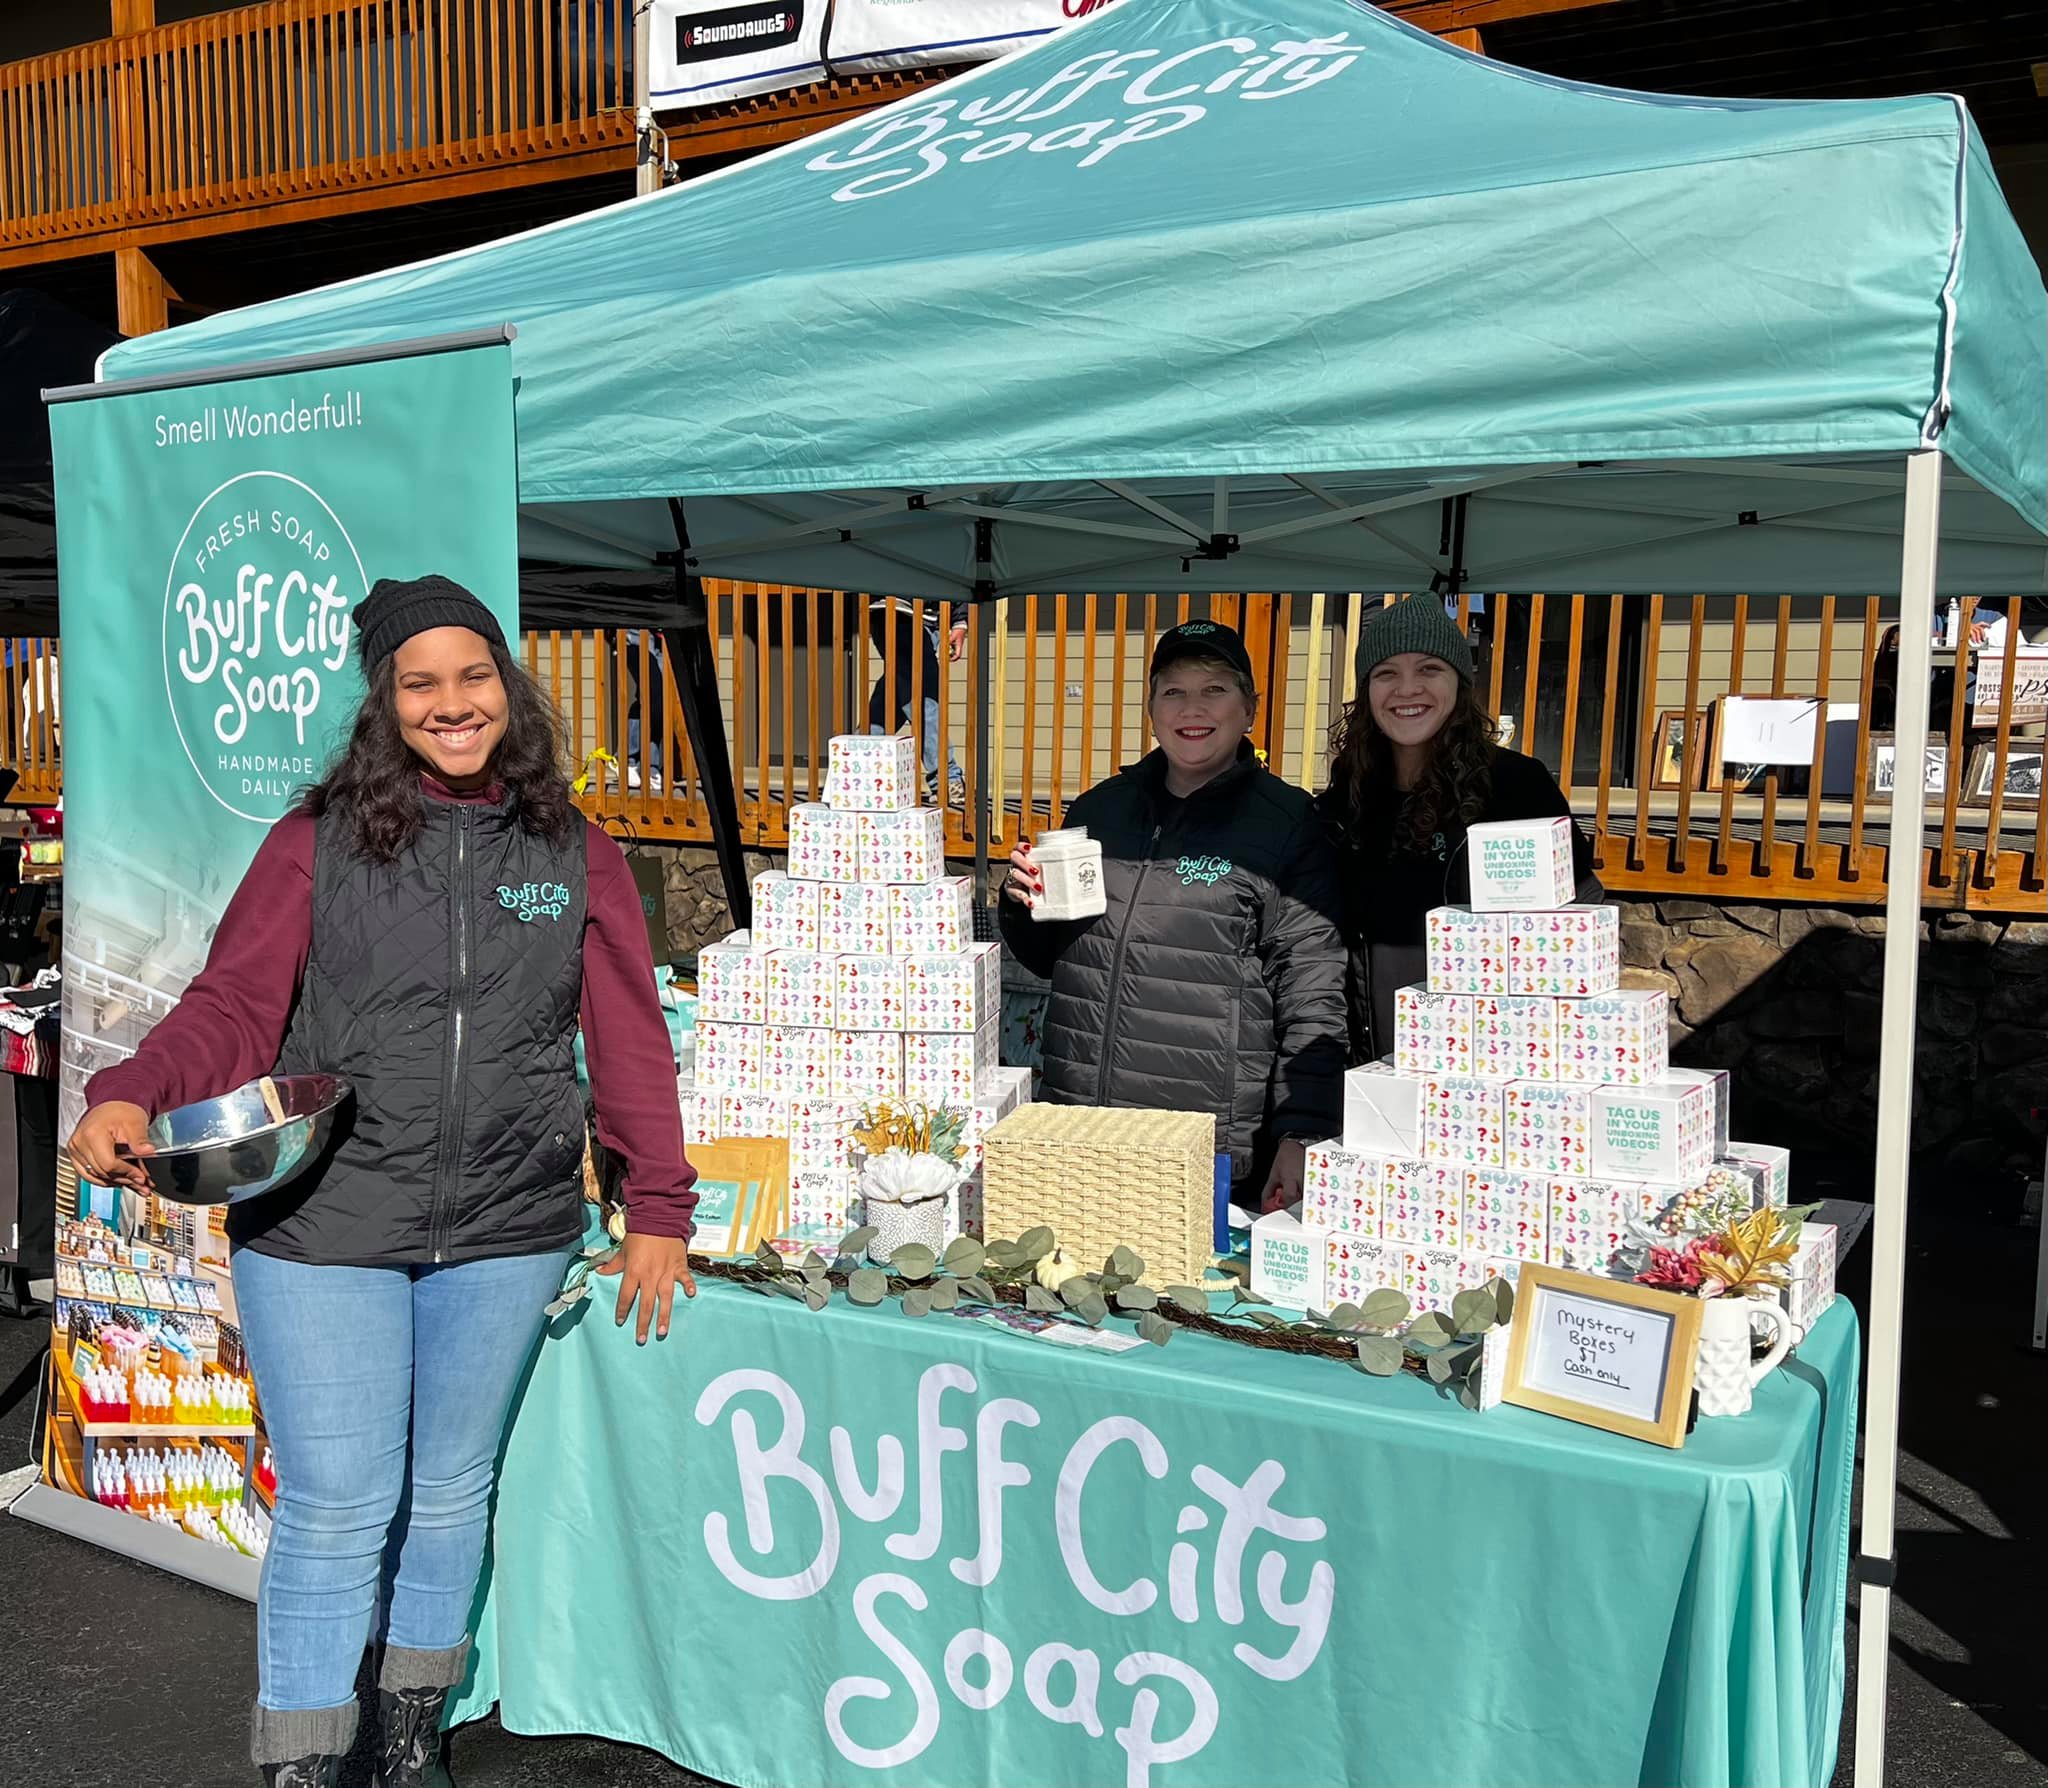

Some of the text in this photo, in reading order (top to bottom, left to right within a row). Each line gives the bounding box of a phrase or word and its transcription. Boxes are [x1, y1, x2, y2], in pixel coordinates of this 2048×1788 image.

[804, 31, 1367, 171] Buff City
[830, 104, 1207, 202] Soap
[155, 390, 363, 447] Smell Wonderful!
[195, 509, 330, 574] FRESH SOAP
[175, 563, 350, 684] Buff City
[214, 658, 320, 745] Soap
[218, 755, 313, 774] HANDMADE
[242, 779, 291, 796] DAILY
[1482, 839, 1536, 850] TAG US
[1176, 855, 1232, 875] Buff City
[1484, 851, 1535, 861] IN YOUR
[1484, 861, 1536, 869] UNBOXING
[1182, 870, 1218, 887] Soap
[1484, 869, 1536, 879] VIDEOS!
[496, 882, 569, 908] Buff City
[518, 902, 562, 921] Soap
[1606, 1107, 1660, 1120] TAG US
[1607, 1119, 1659, 1131] IN YOUR
[1607, 1129, 1660, 1140] UNBOXING
[1607, 1137, 1660, 1150] VIDEOS!
[1263, 1239, 1309, 1256] TAG US
[1263, 1259, 1308, 1273] UNBOXING
[1264, 1250, 1308, 1265] IN YOUR
[1263, 1267, 1308, 1283] VIDEOS!
[1558, 1309, 1634, 1344] Mystery
[1569, 1330, 1616, 1354] Boxes
[1580, 1347, 1596, 1363] $7
[1564, 1358, 1620, 1384] Cash only
[694, 1363, 1336, 1682] Buff City
[823, 1571, 1220, 1788] Soap
